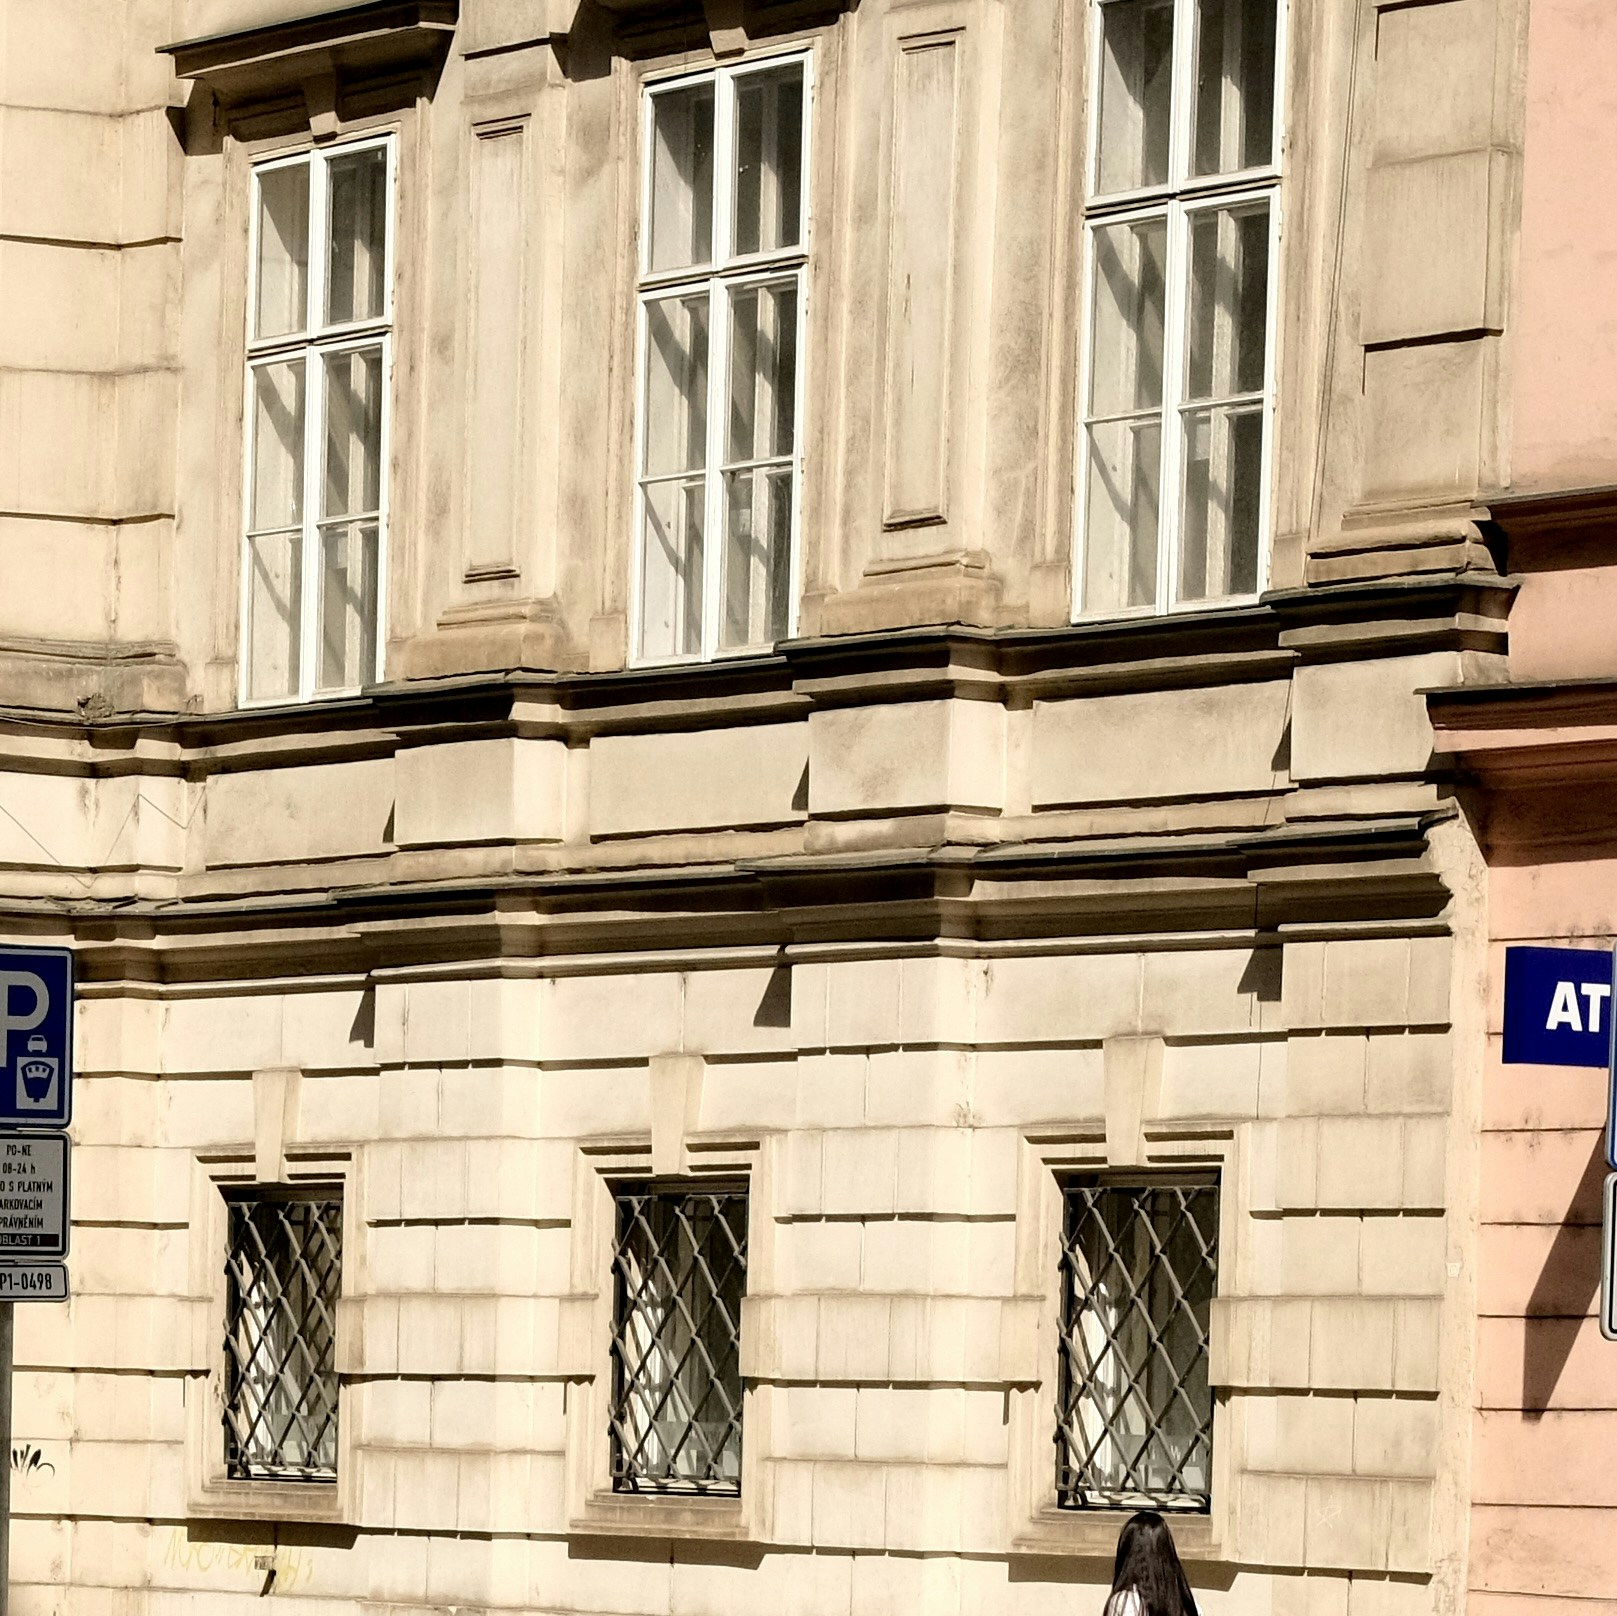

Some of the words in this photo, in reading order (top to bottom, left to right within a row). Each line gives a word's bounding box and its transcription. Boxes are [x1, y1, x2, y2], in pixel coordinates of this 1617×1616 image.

[1546, 981, 1611, 1033] AT
[6, 1145, 32, 1156] PO-NE
[2, 1163, 27, 1174] 08-24
[30, 1163, 36, 1174] h
[9, 1181, 14, 1192] S
[18, 1178, 53, 1193] PLATNÝM
[36, 1235, 41, 1245] 1
[0, 1272, 53, 1291] P1-0498
